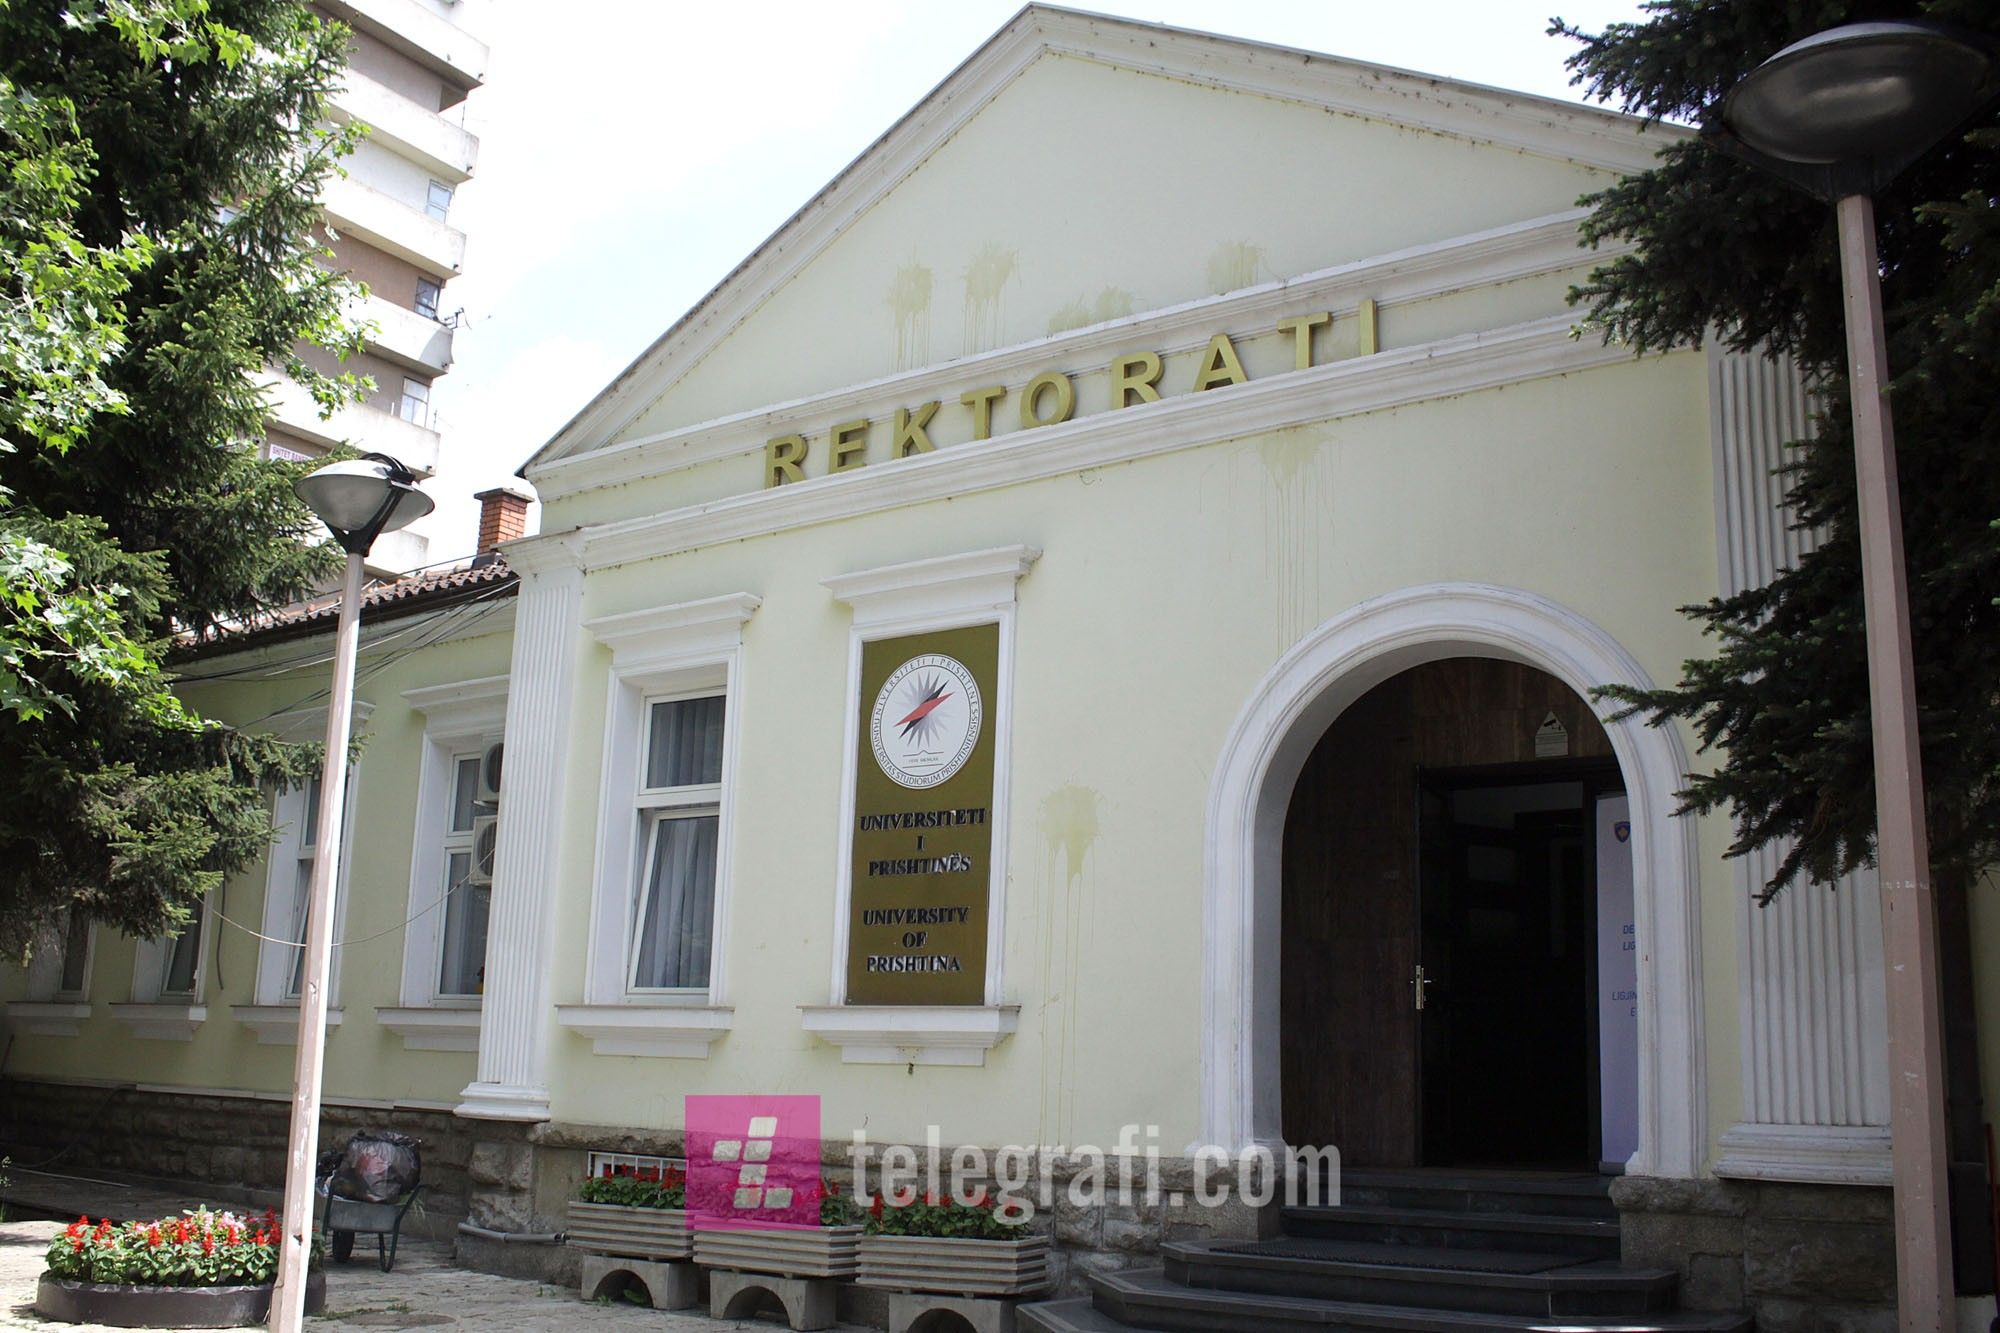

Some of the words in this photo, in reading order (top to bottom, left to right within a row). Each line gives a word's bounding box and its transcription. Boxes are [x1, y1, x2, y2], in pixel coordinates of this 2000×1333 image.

[764, 298, 1378, 488] REKTORATI
[874, 658, 926, 725] UNIVERSITETI
[873, 726, 896, 776] UNIVERSITAS
[896, 770, 941, 785] STUDIORUM
[860, 808, 985, 831] UNIVERSITETI
[917, 835, 924, 850] I
[869, 852, 971, 876] PRISHTINËS
[863, 907, 969, 925] UNIVERSITY
[902, 931, 927, 948] OF
[867, 956, 960, 972] PRISHTINA
